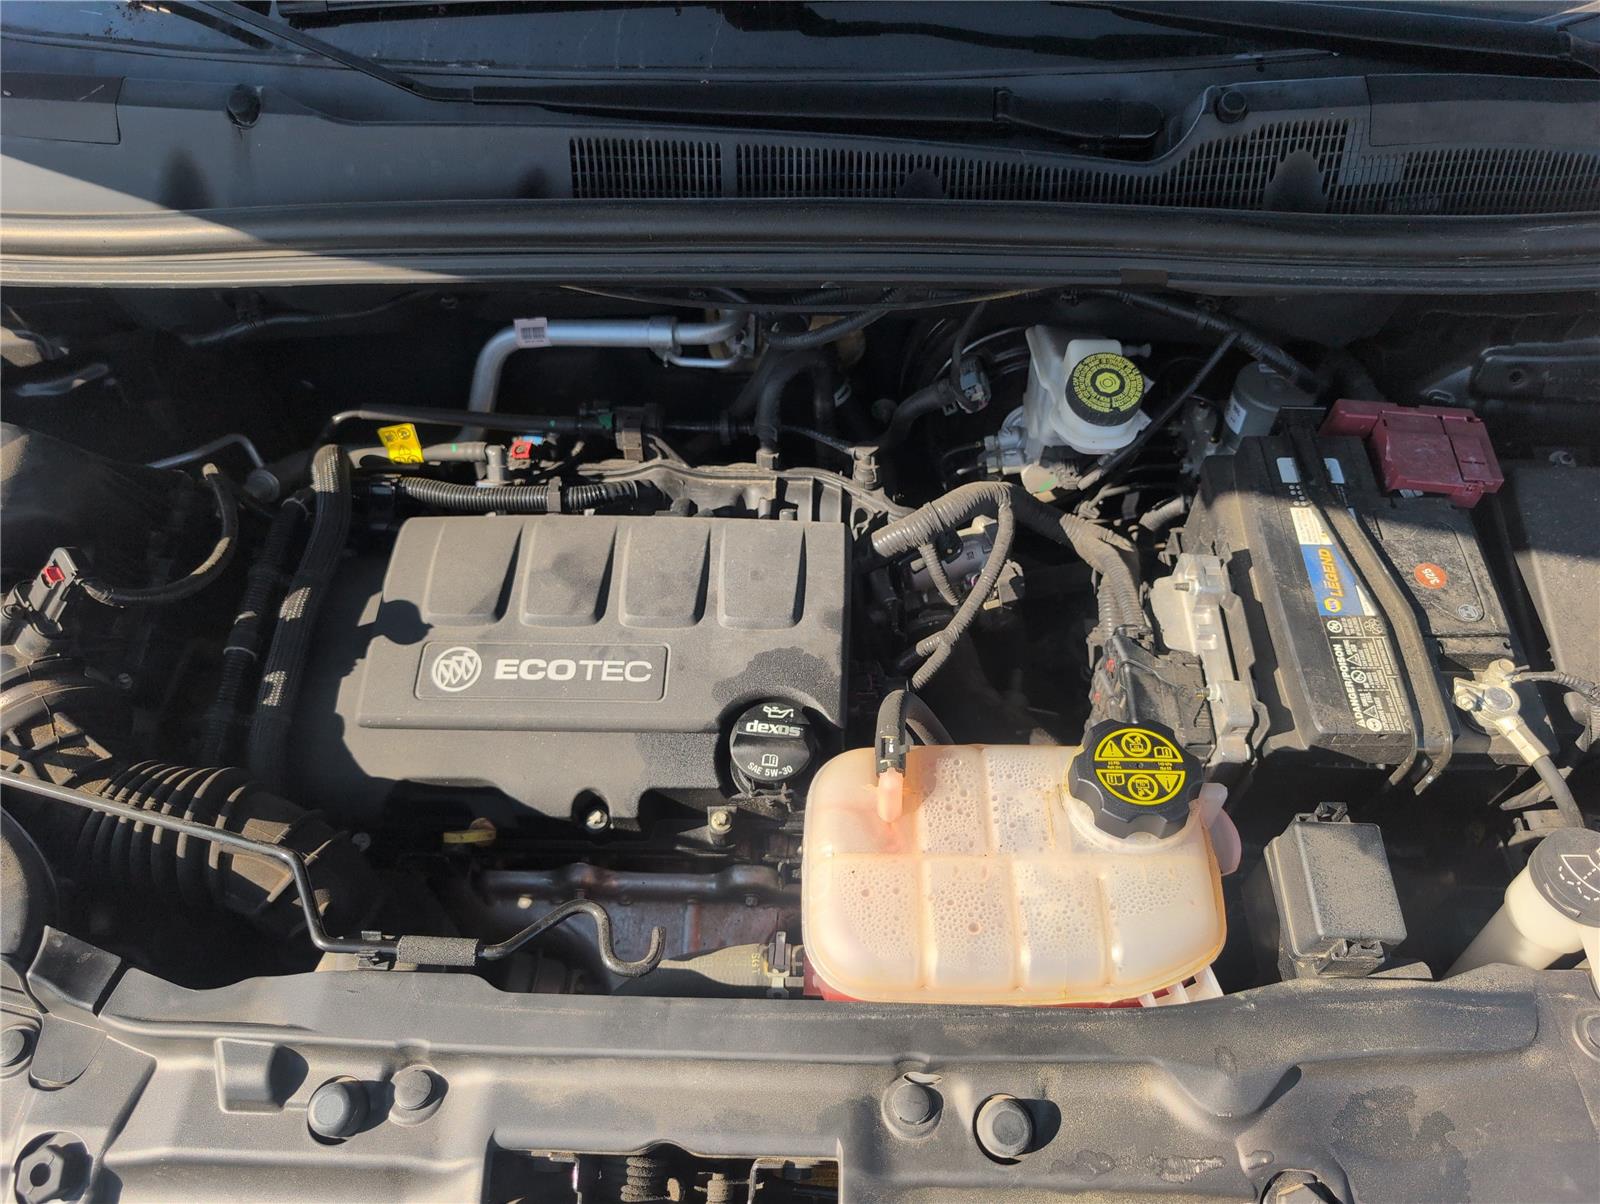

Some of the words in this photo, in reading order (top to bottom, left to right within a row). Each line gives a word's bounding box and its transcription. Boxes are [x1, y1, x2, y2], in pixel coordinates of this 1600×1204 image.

[1318, 548, 1344, 597] LEGEND
[494, 659, 652, 682] ECOTEC
[1333, 644, 1364, 719] DANGER/POISON
[745, 719, 801, 737] dexos
[747, 762, 762, 775] SAE
[764, 765, 793, 777] 5W-30
